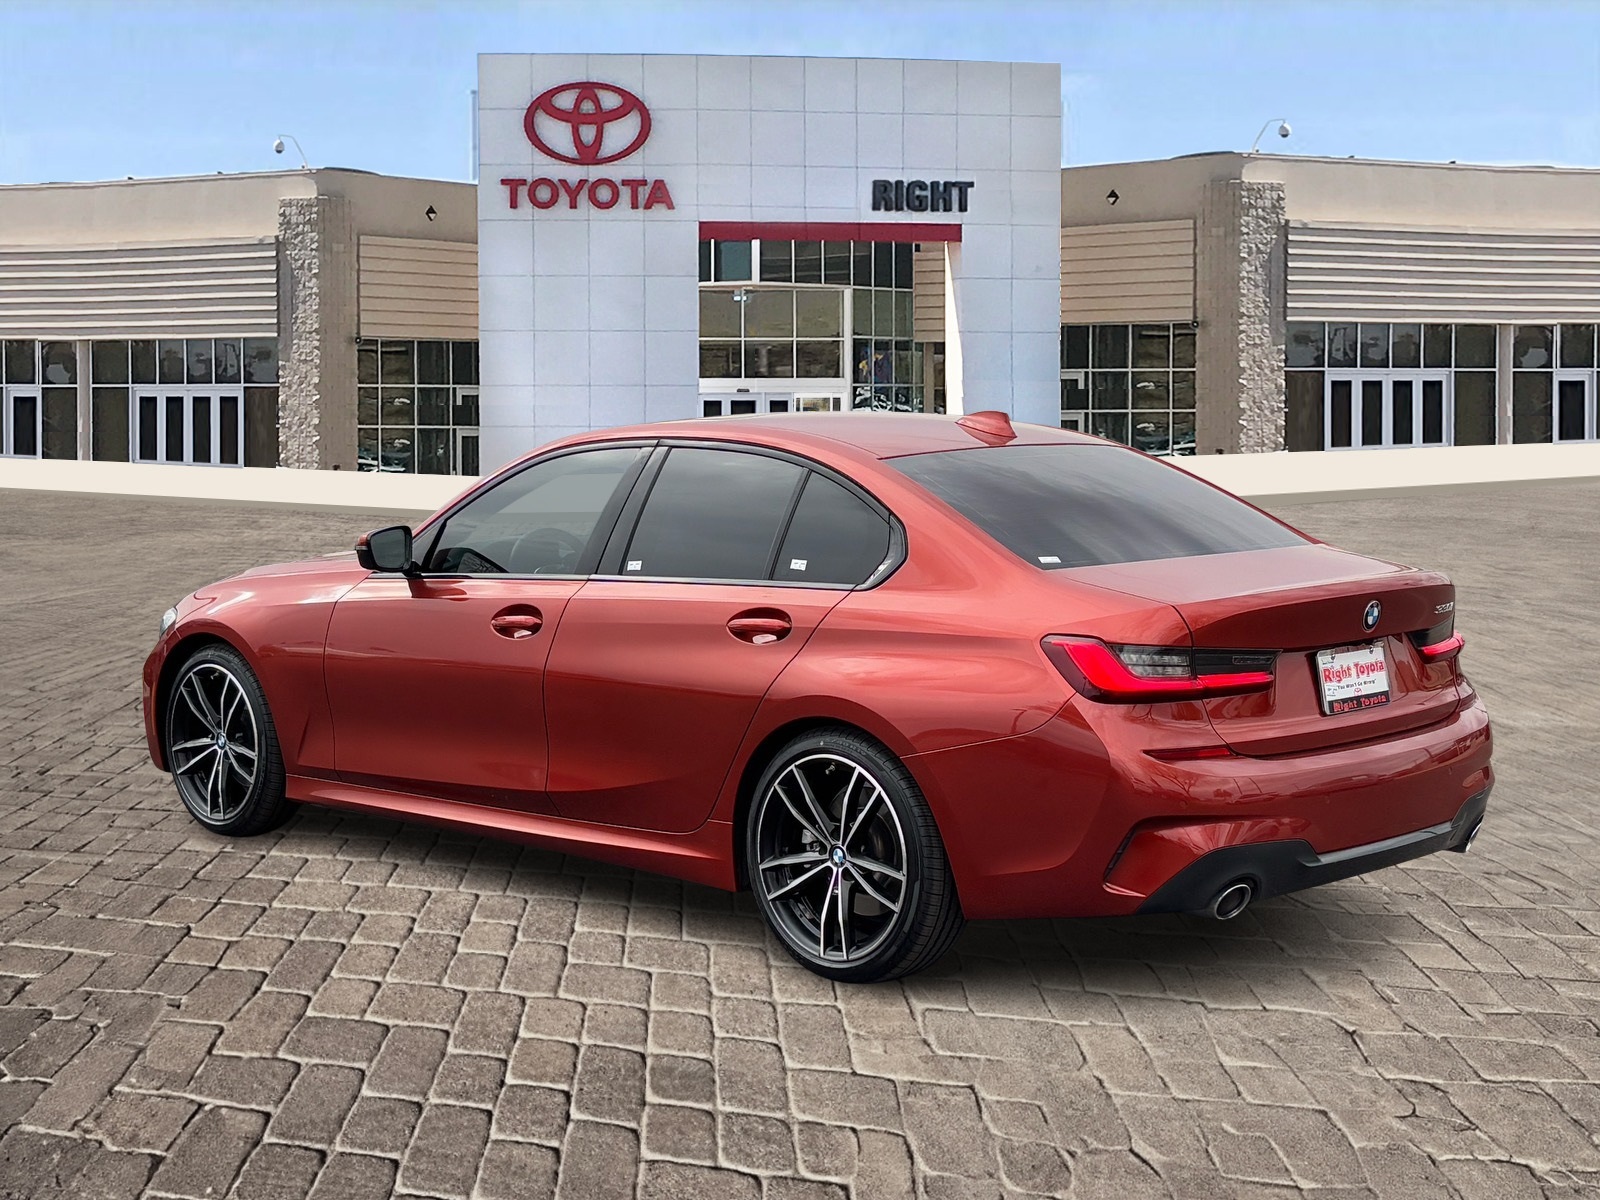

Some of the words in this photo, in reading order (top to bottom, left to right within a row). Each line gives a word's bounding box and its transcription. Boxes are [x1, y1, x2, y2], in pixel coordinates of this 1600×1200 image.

[500, 177, 675, 210] TOYOTA
[872, 179, 975, 212] RIGHT
[1322, 664, 1352, 683] Right
[1353, 659, 1385, 678] Toyota
[1333, 700, 1358, 712] Right
[1361, 695, 1387, 707] Toyota
